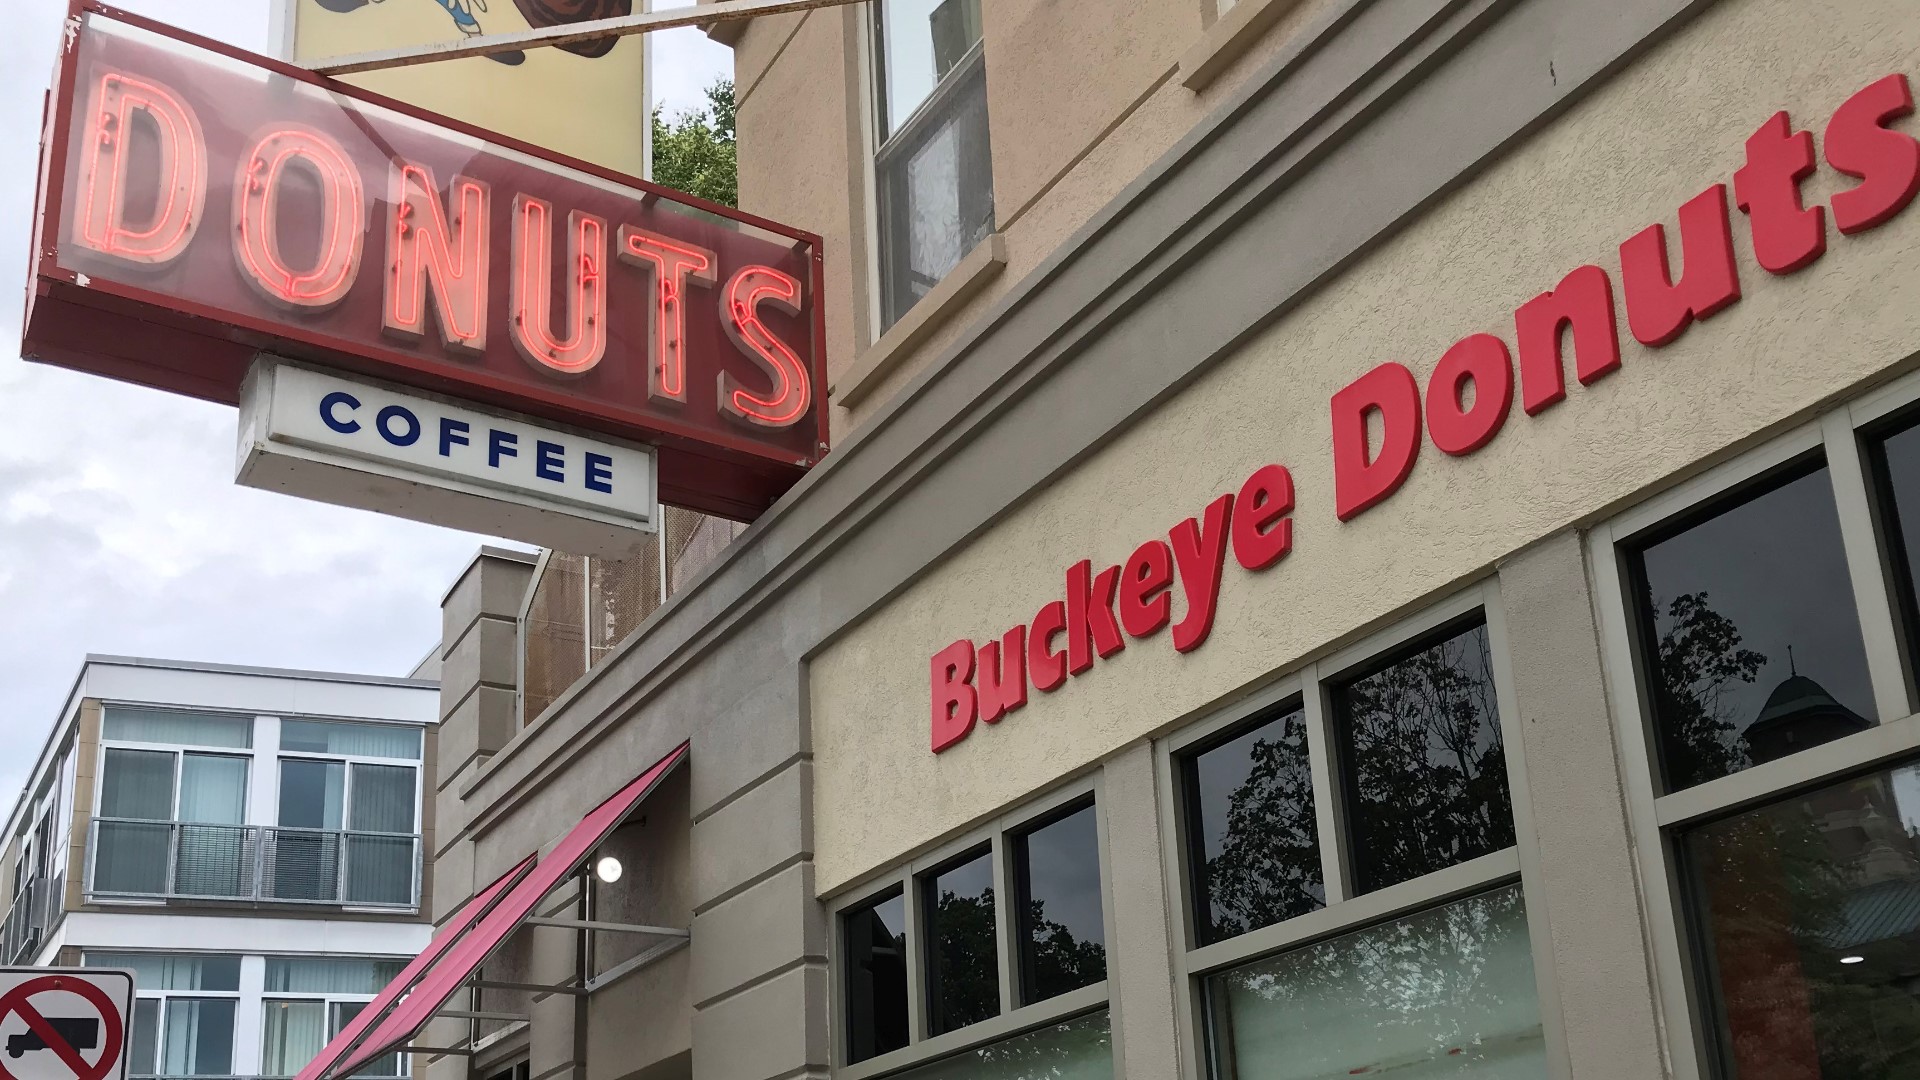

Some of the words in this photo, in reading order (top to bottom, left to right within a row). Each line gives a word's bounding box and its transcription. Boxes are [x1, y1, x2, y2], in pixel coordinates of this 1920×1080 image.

[71, 66, 812, 429] DONUTS
[931, 463, 1294, 754] Buckeye
[1331, 73, 1920, 523] Donuts
[319, 391, 613, 494] COFFEE
